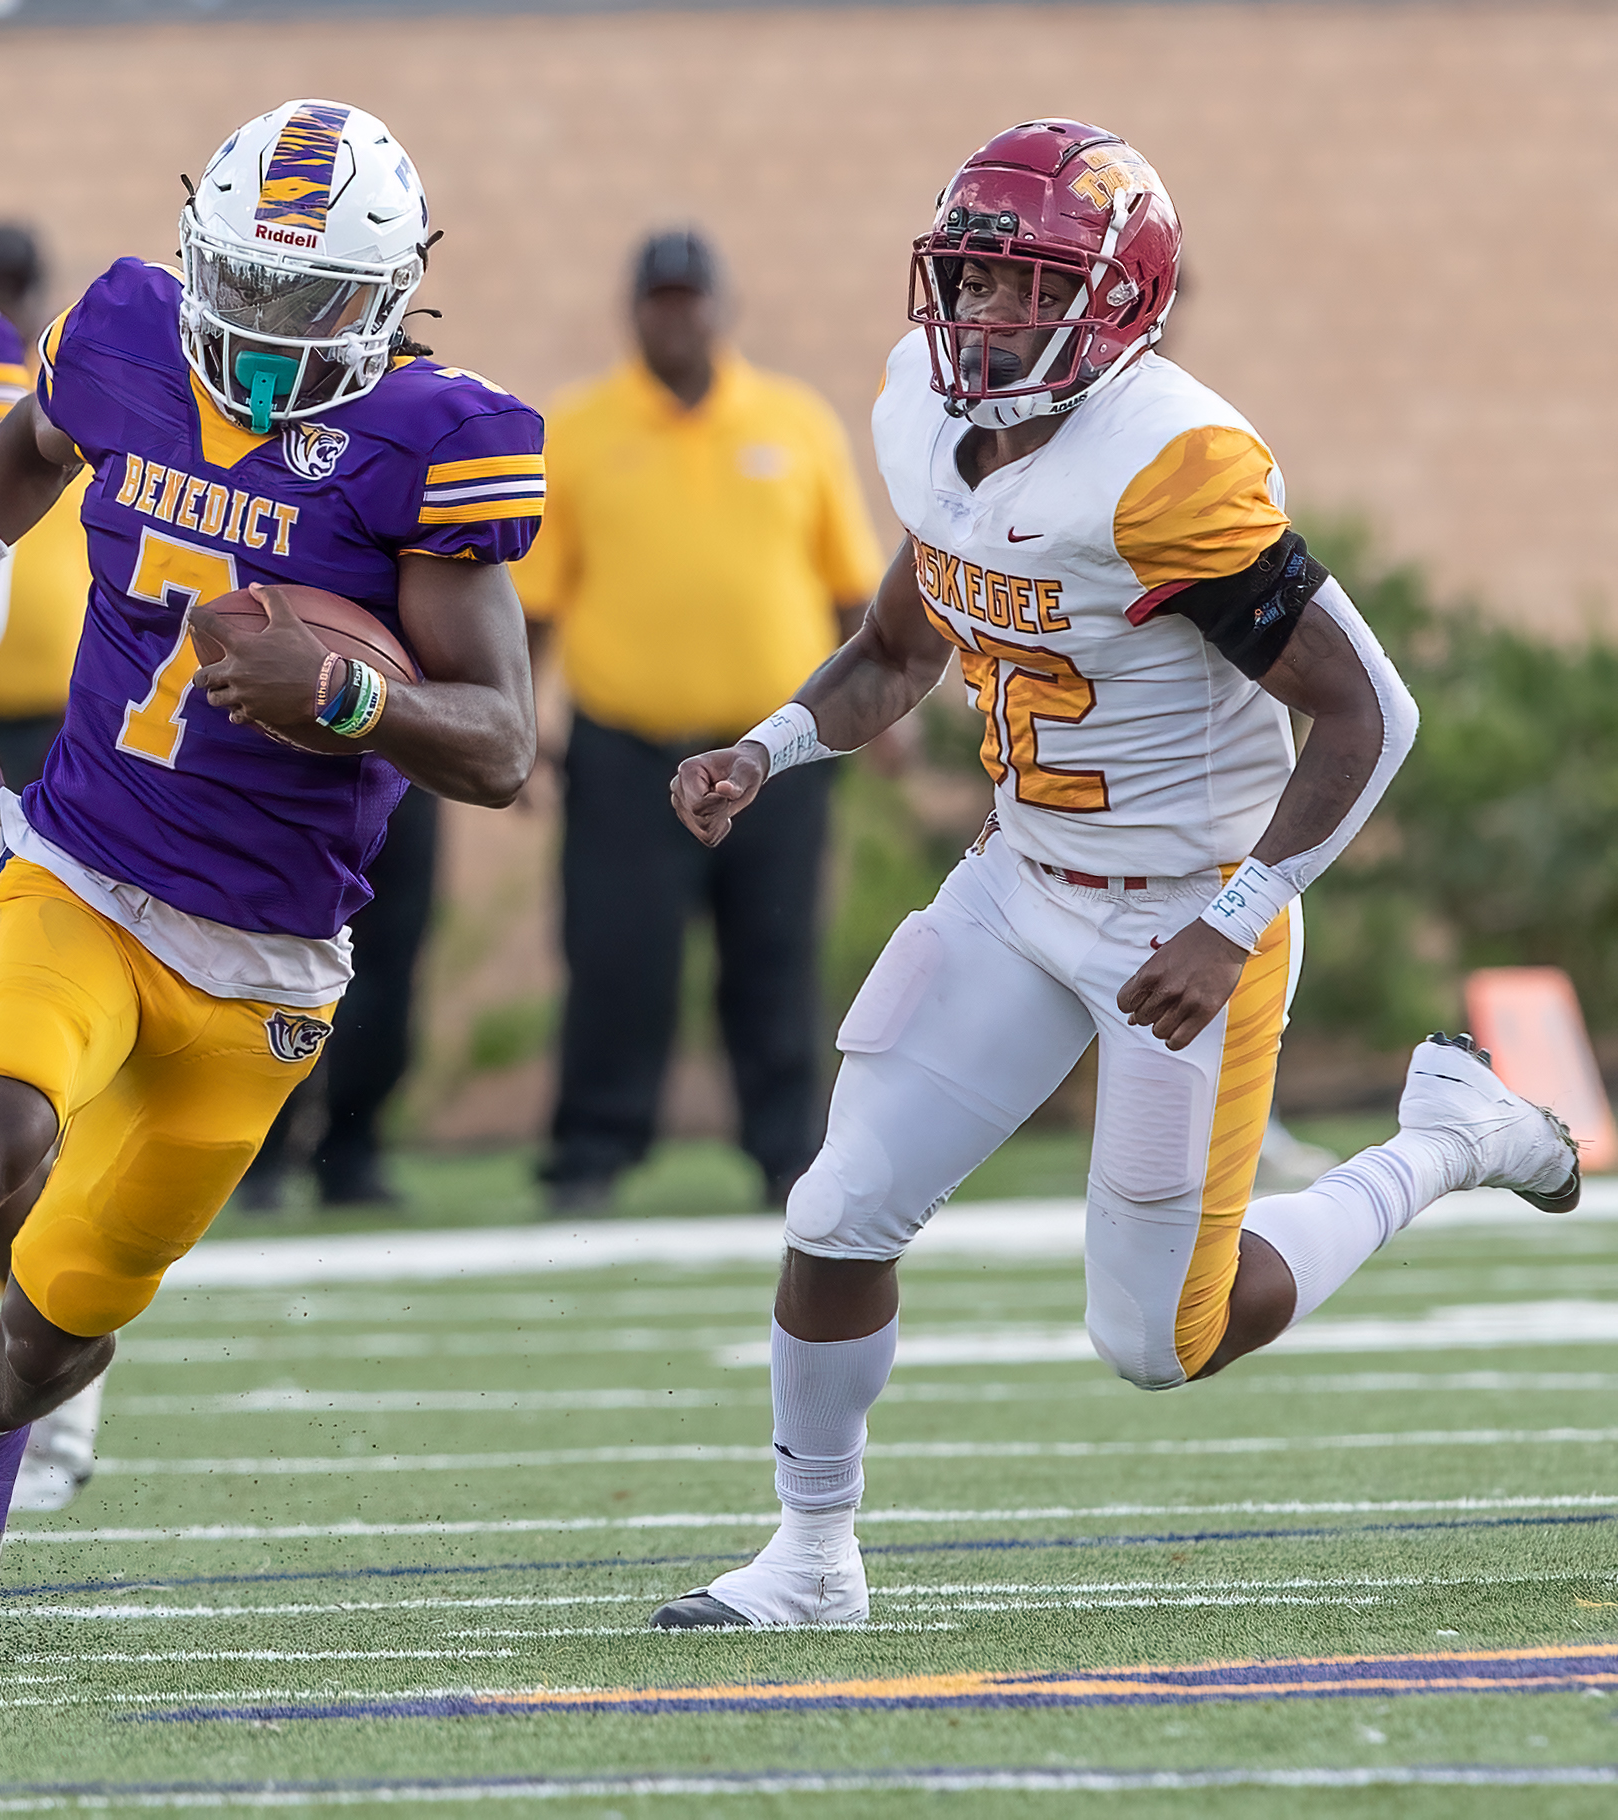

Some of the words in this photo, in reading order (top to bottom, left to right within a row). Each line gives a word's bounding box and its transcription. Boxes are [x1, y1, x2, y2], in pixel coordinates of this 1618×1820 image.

[254, 223, 318, 249] Riddell
[115, 452, 299, 556] BENEDICT
[115, 525, 239, 769] 7
